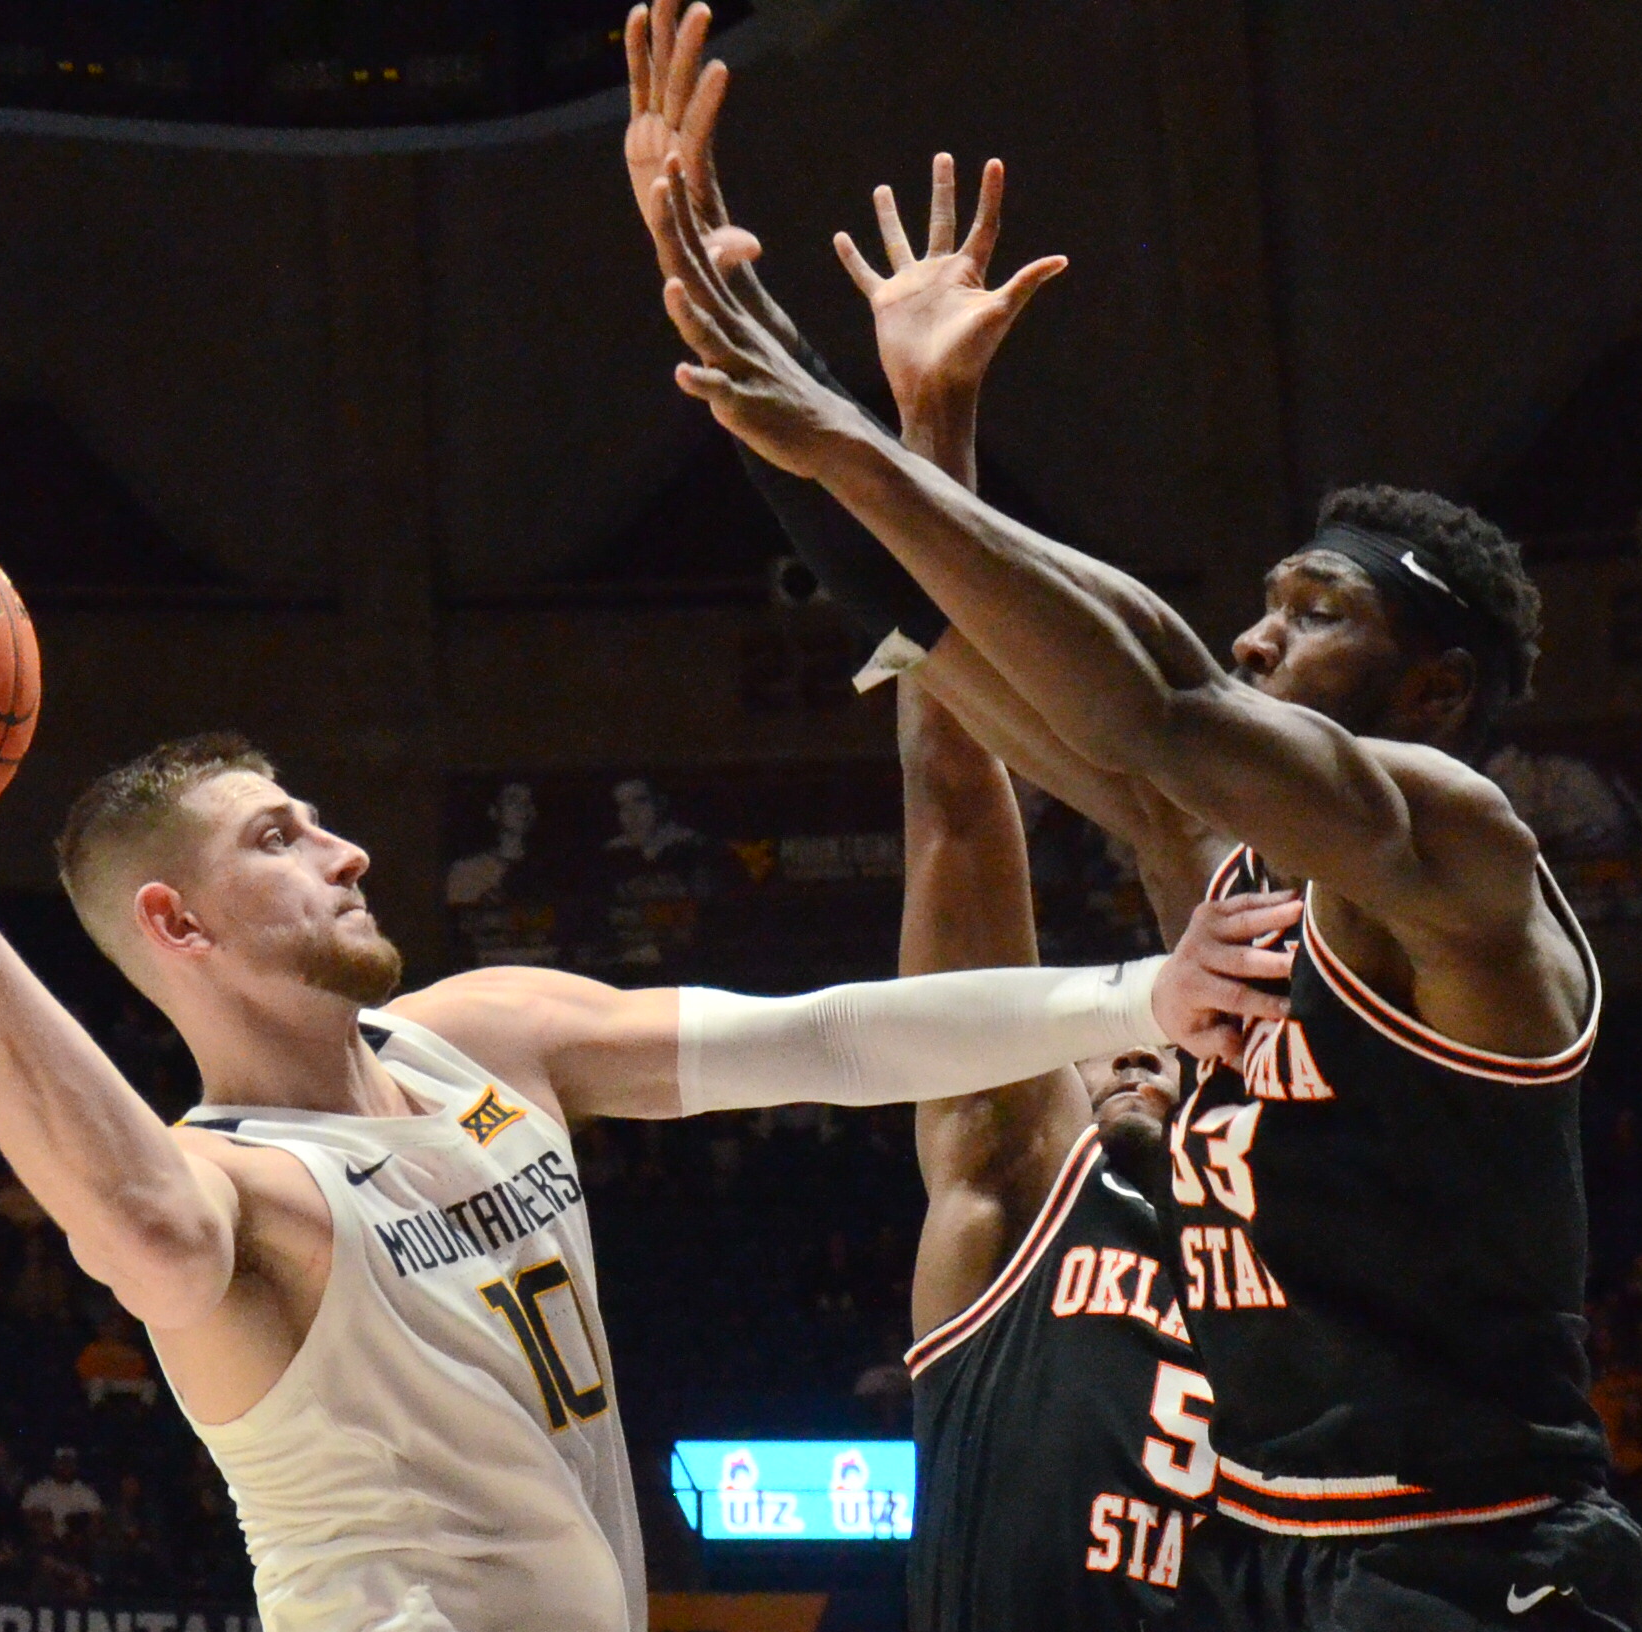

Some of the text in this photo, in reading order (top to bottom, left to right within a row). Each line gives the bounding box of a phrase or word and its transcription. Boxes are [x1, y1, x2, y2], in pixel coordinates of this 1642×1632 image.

[477, 1257, 608, 1430] 10
[1140, 1358, 1219, 1500] 5
[1085, 1491, 1208, 1591] STA
